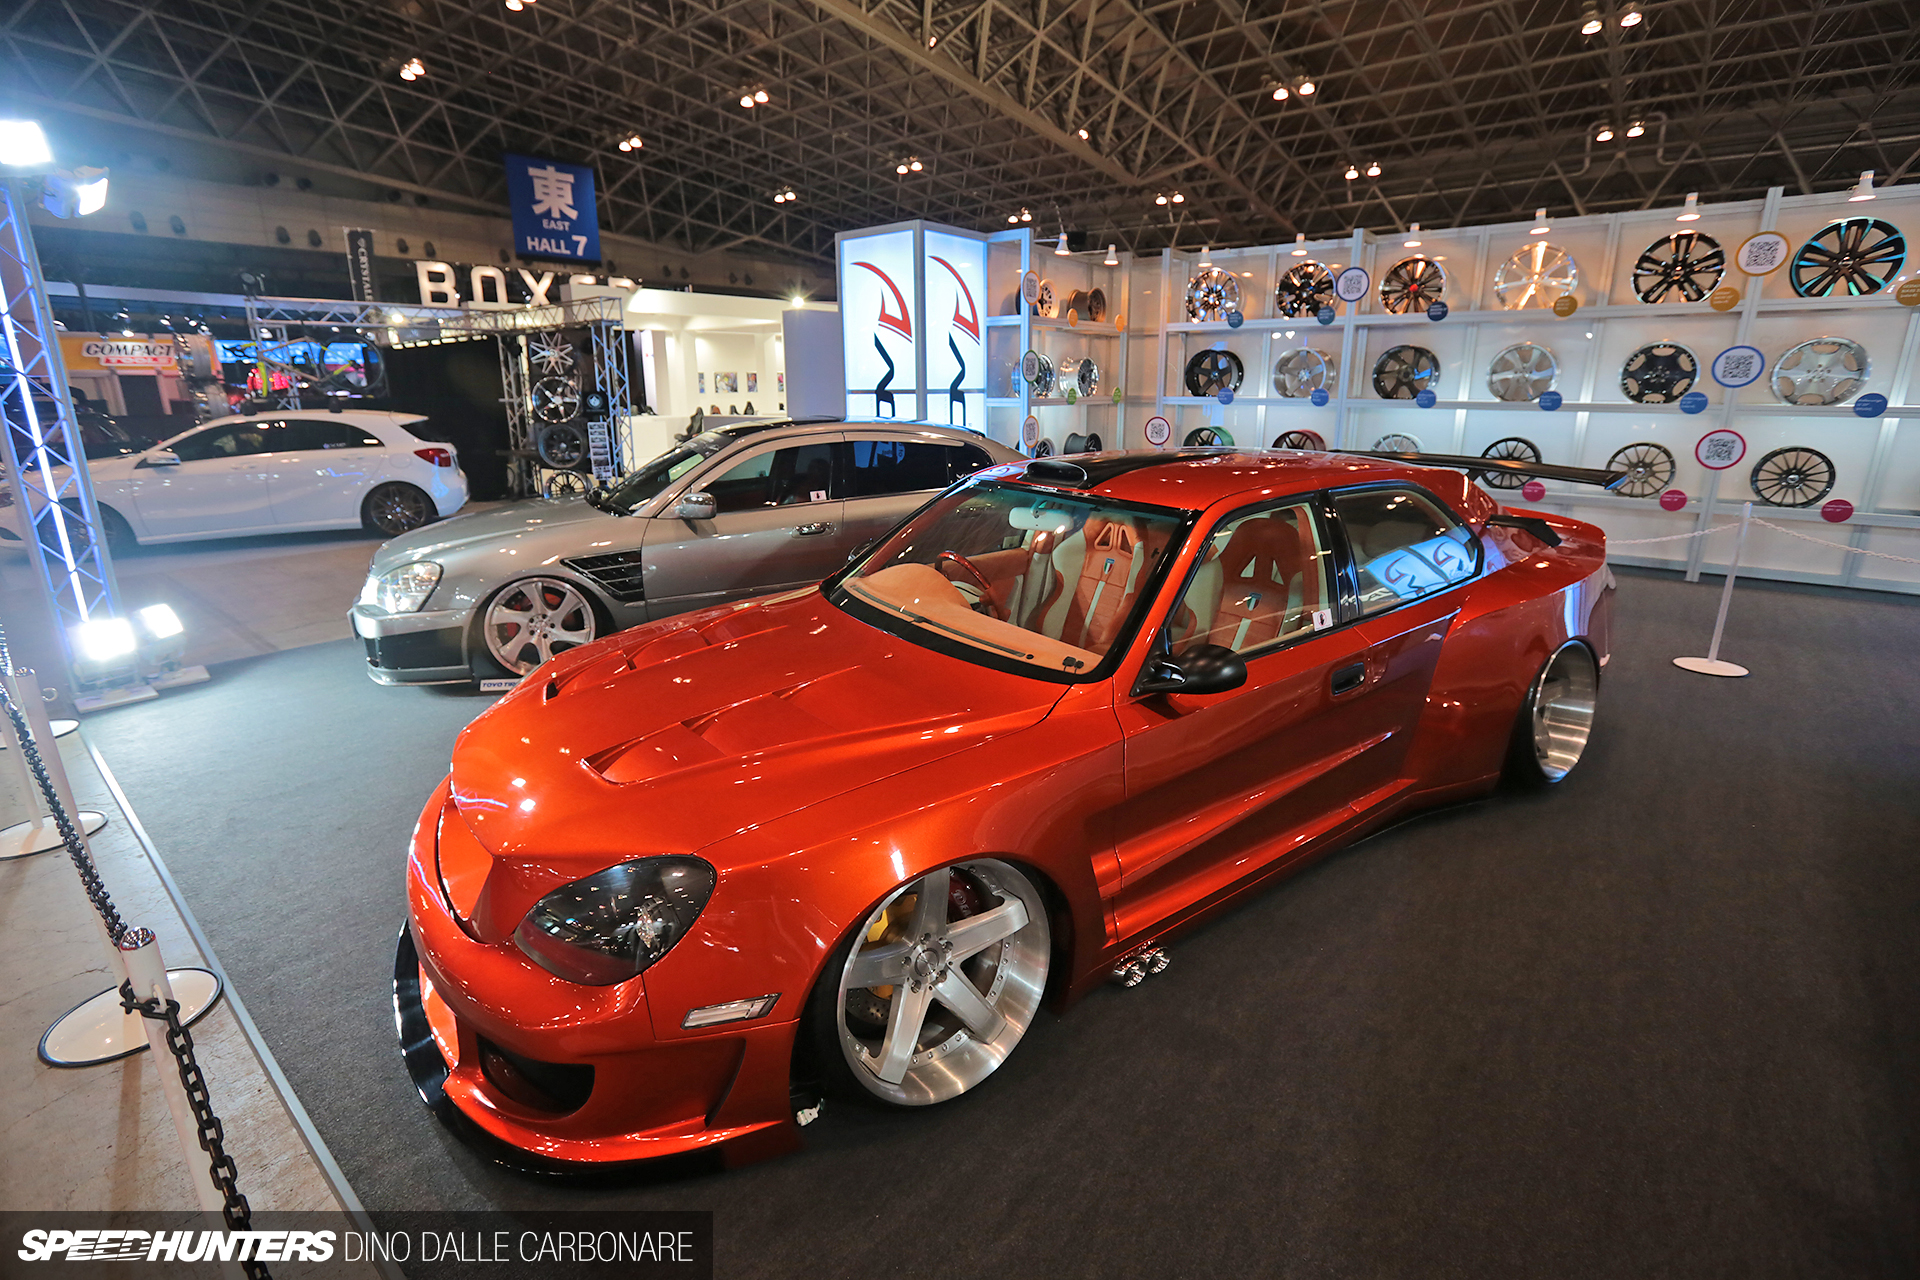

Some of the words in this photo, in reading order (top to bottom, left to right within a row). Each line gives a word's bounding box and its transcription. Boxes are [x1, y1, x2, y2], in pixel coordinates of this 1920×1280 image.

[527, 165, 578, 221] 東
[542, 219, 571, 232] EAST
[526, 236, 571, 255] HALL
[571, 235, 588, 257] 7
[415, 260, 639, 308] BOX
[86, 343, 172, 357] COMPACT
